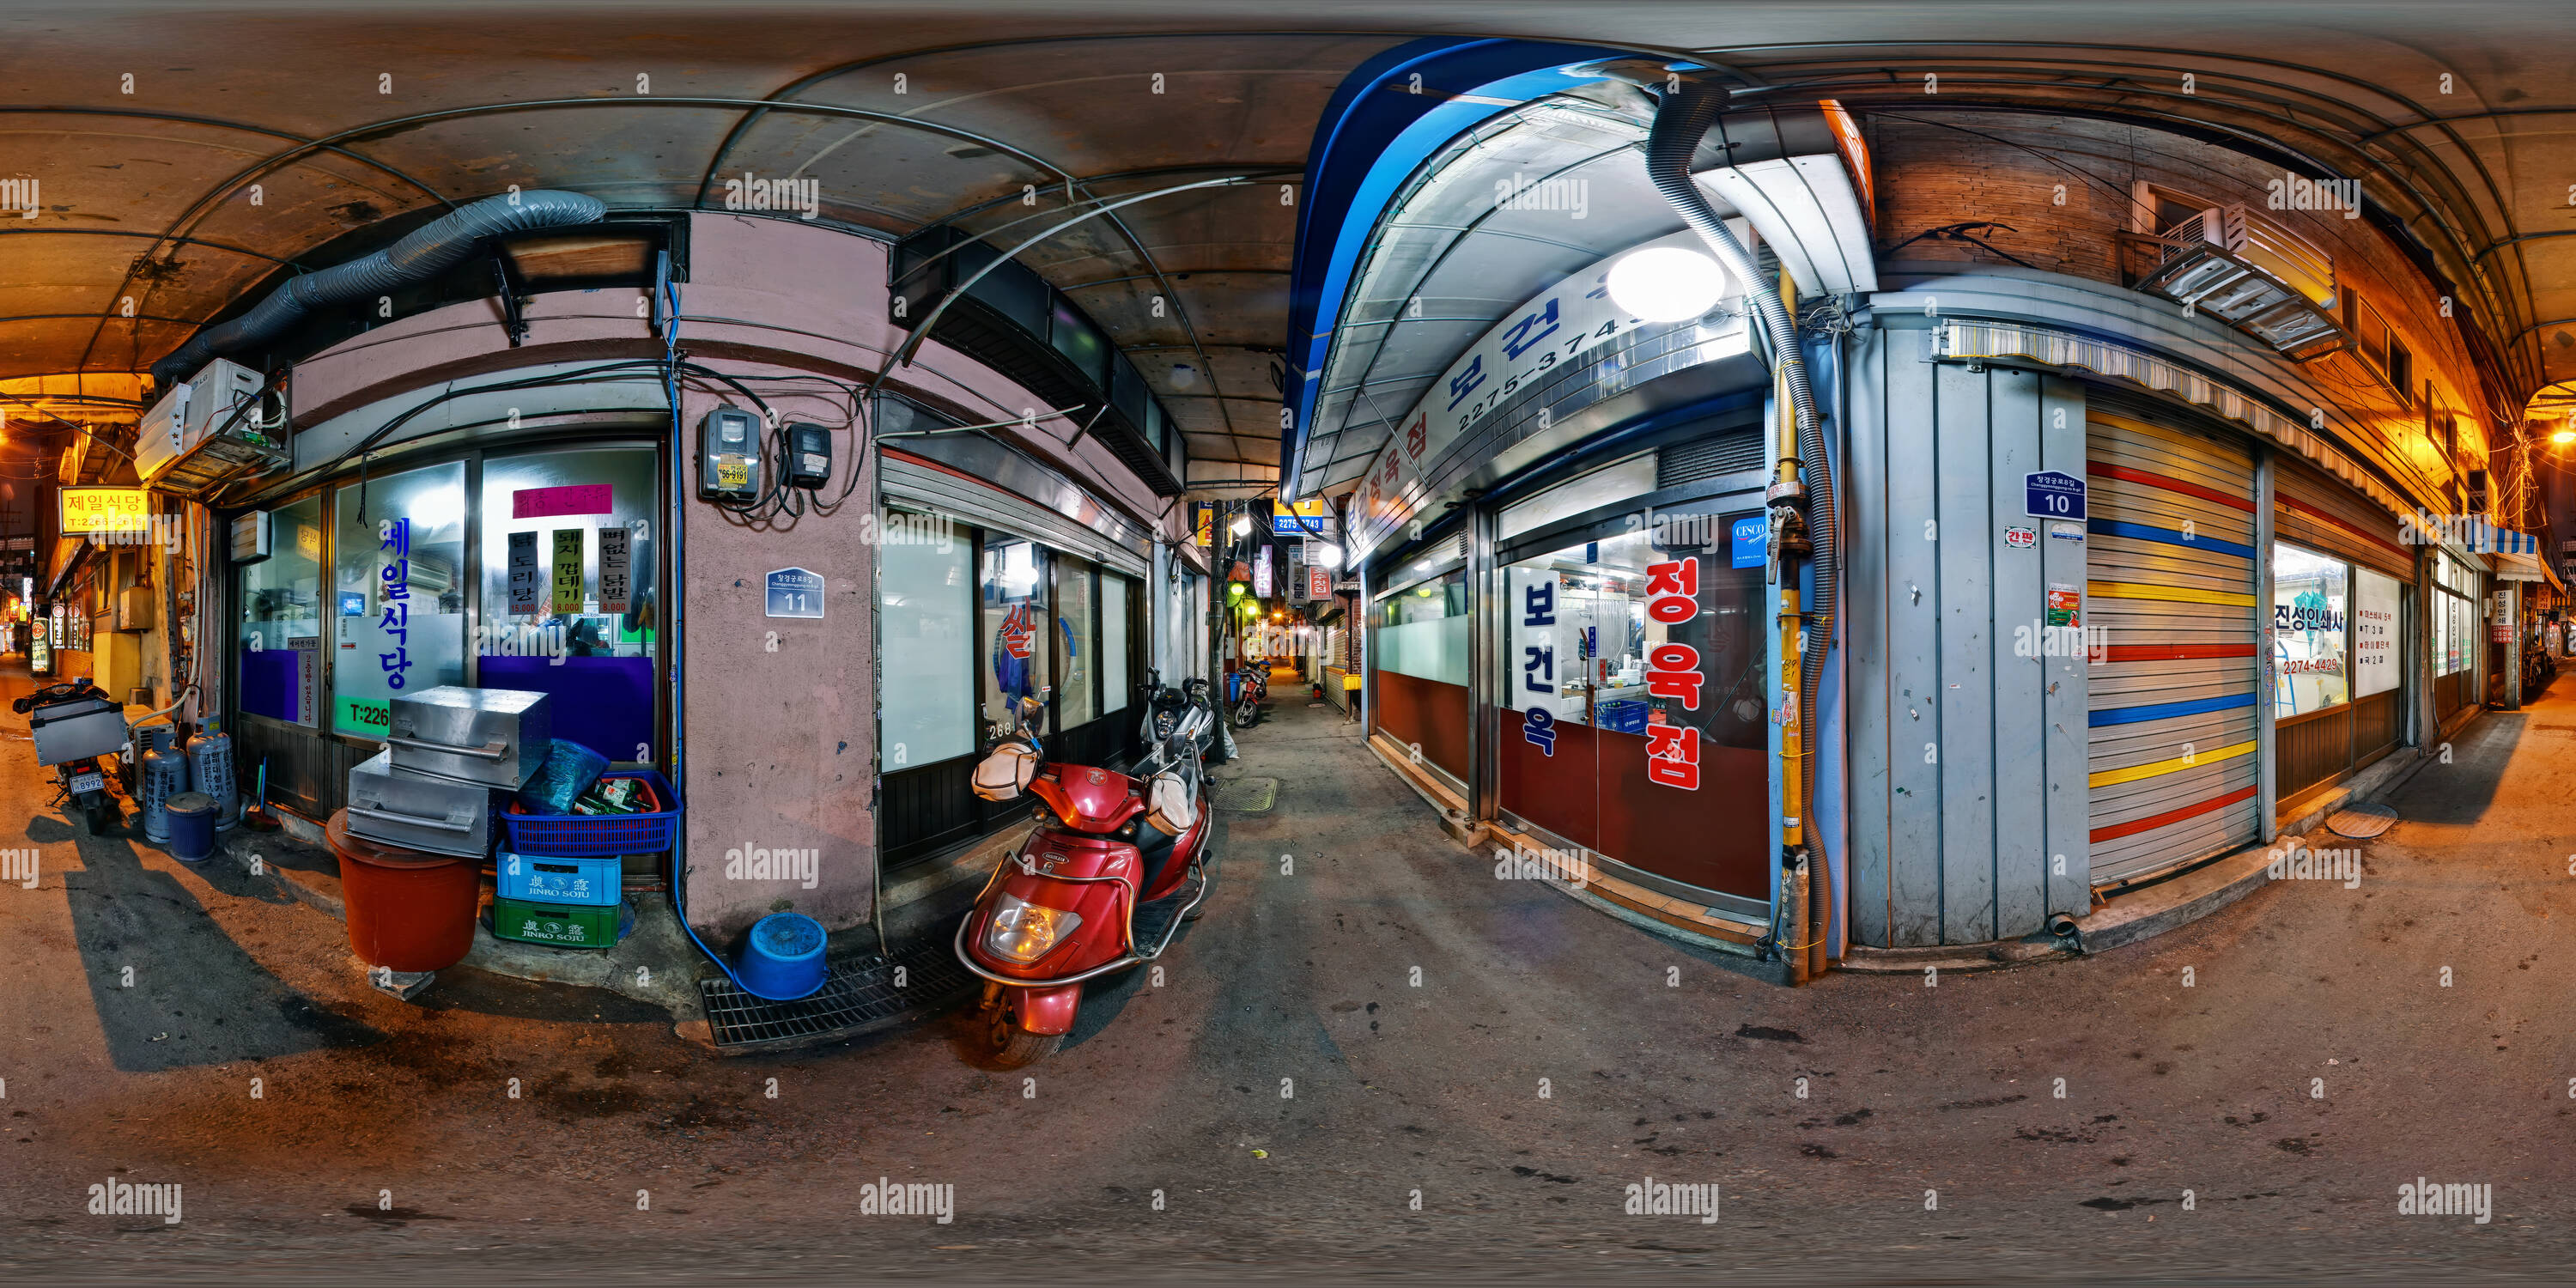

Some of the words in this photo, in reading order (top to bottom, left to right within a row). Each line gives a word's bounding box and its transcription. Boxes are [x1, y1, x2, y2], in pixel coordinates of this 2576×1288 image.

[1447, 296, 1560, 413] 보건
[1459, 314, 1644, 431] 2275-374
[2036, 475, 2075, 488] 창경궁로8길
[68, 495, 142, 512] 제일식당
[2044, 494, 2070, 513] 10
[1736, 523, 1765, 538] CESCO
[2008, 530, 2034, 544] 간판
[777, 574, 813, 584] 창경궁로8길
[379, 517, 412, 690] 제일식당
[785, 592, 805, 612] 11
[2497, 591, 2506, 625] 진성인쇄
[2275, 604, 2344, 633] 진성인쇄사
[1644, 556, 1705, 791] 정육점
[2283, 658, 2338, 676] 2274-4429
[528, 887, 559, 897] JINRO
[562, 889, 590, 899] SOJU
[521, 929, 553, 939] JINRO
[556, 932, 585, 942] SOJU
